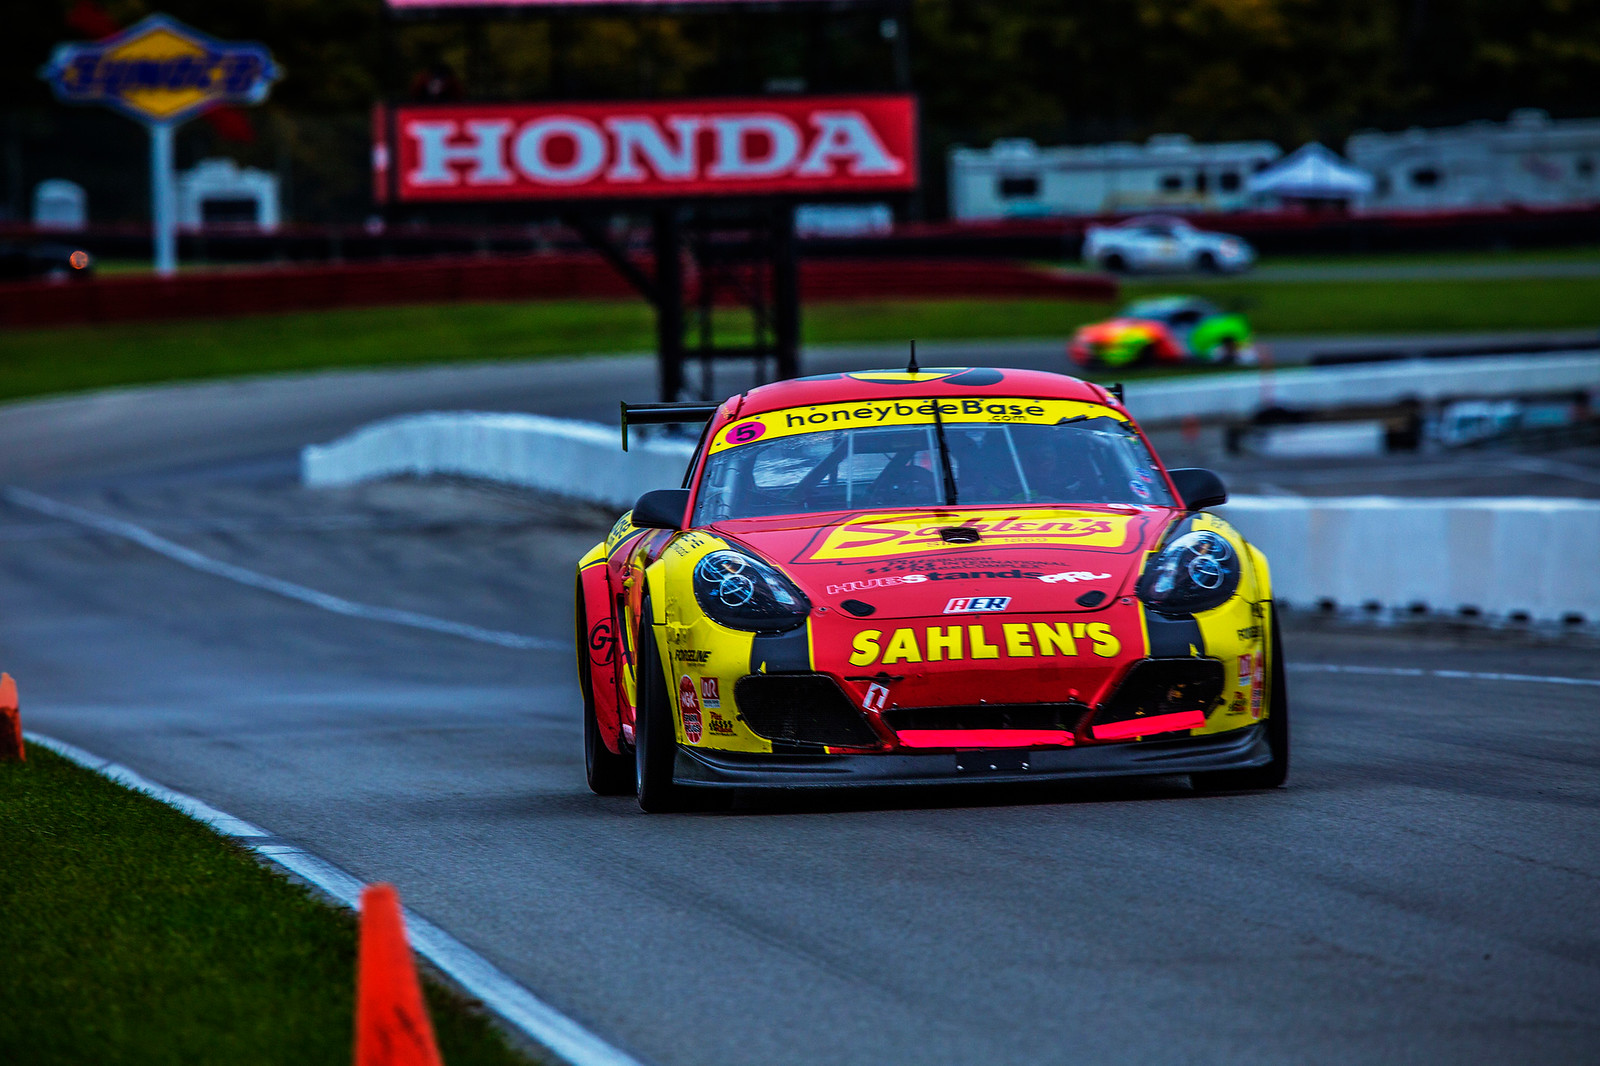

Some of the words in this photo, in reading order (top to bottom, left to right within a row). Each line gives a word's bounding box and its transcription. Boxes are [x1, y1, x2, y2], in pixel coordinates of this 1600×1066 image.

[407, 110, 905, 187] HONDA
[736, 424, 756, 442] 5
[786, 399, 1045, 428] honeybeeBase
[987, 414, 1028, 422] .com
[834, 513, 1113, 549] Sahlen's
[948, 597, 1007, 610] AER
[590, 624, 619, 662] GT
[849, 622, 1121, 666] SAHLEN'S
